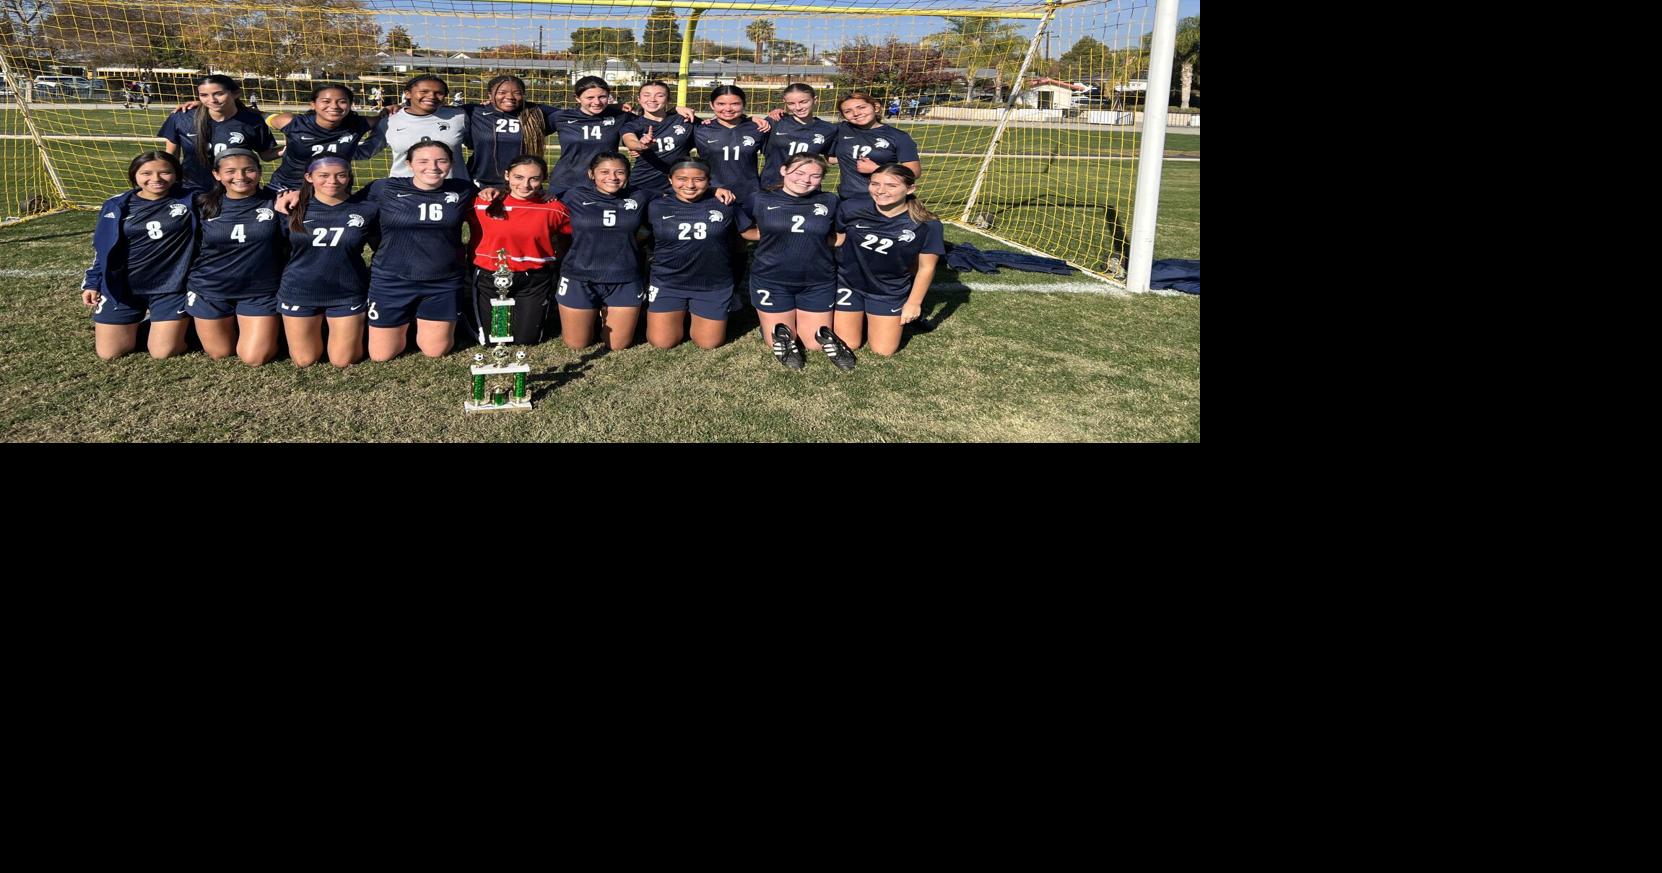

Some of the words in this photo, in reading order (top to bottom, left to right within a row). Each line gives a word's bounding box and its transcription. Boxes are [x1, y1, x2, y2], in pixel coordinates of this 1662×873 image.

[496, 119, 520, 133] 25
[582, 126, 603, 140] 14
[652, 136, 676, 152] 13
[852, 144, 873, 161] 12
[722, 146, 740, 160] 11
[418, 203, 444, 221] 16
[602, 210, 617, 226] 5
[146, 221, 164, 239] 8
[677, 222, 708, 240] 23
[791, 215, 806, 232] 2
[230, 224, 247, 243] 4
[312, 227, 346, 246] 27
[861, 234, 894, 255] 22
[557, 277, 571, 297] 5
[756, 289, 774, 306] 2
[837, 288, 853, 306] 2
